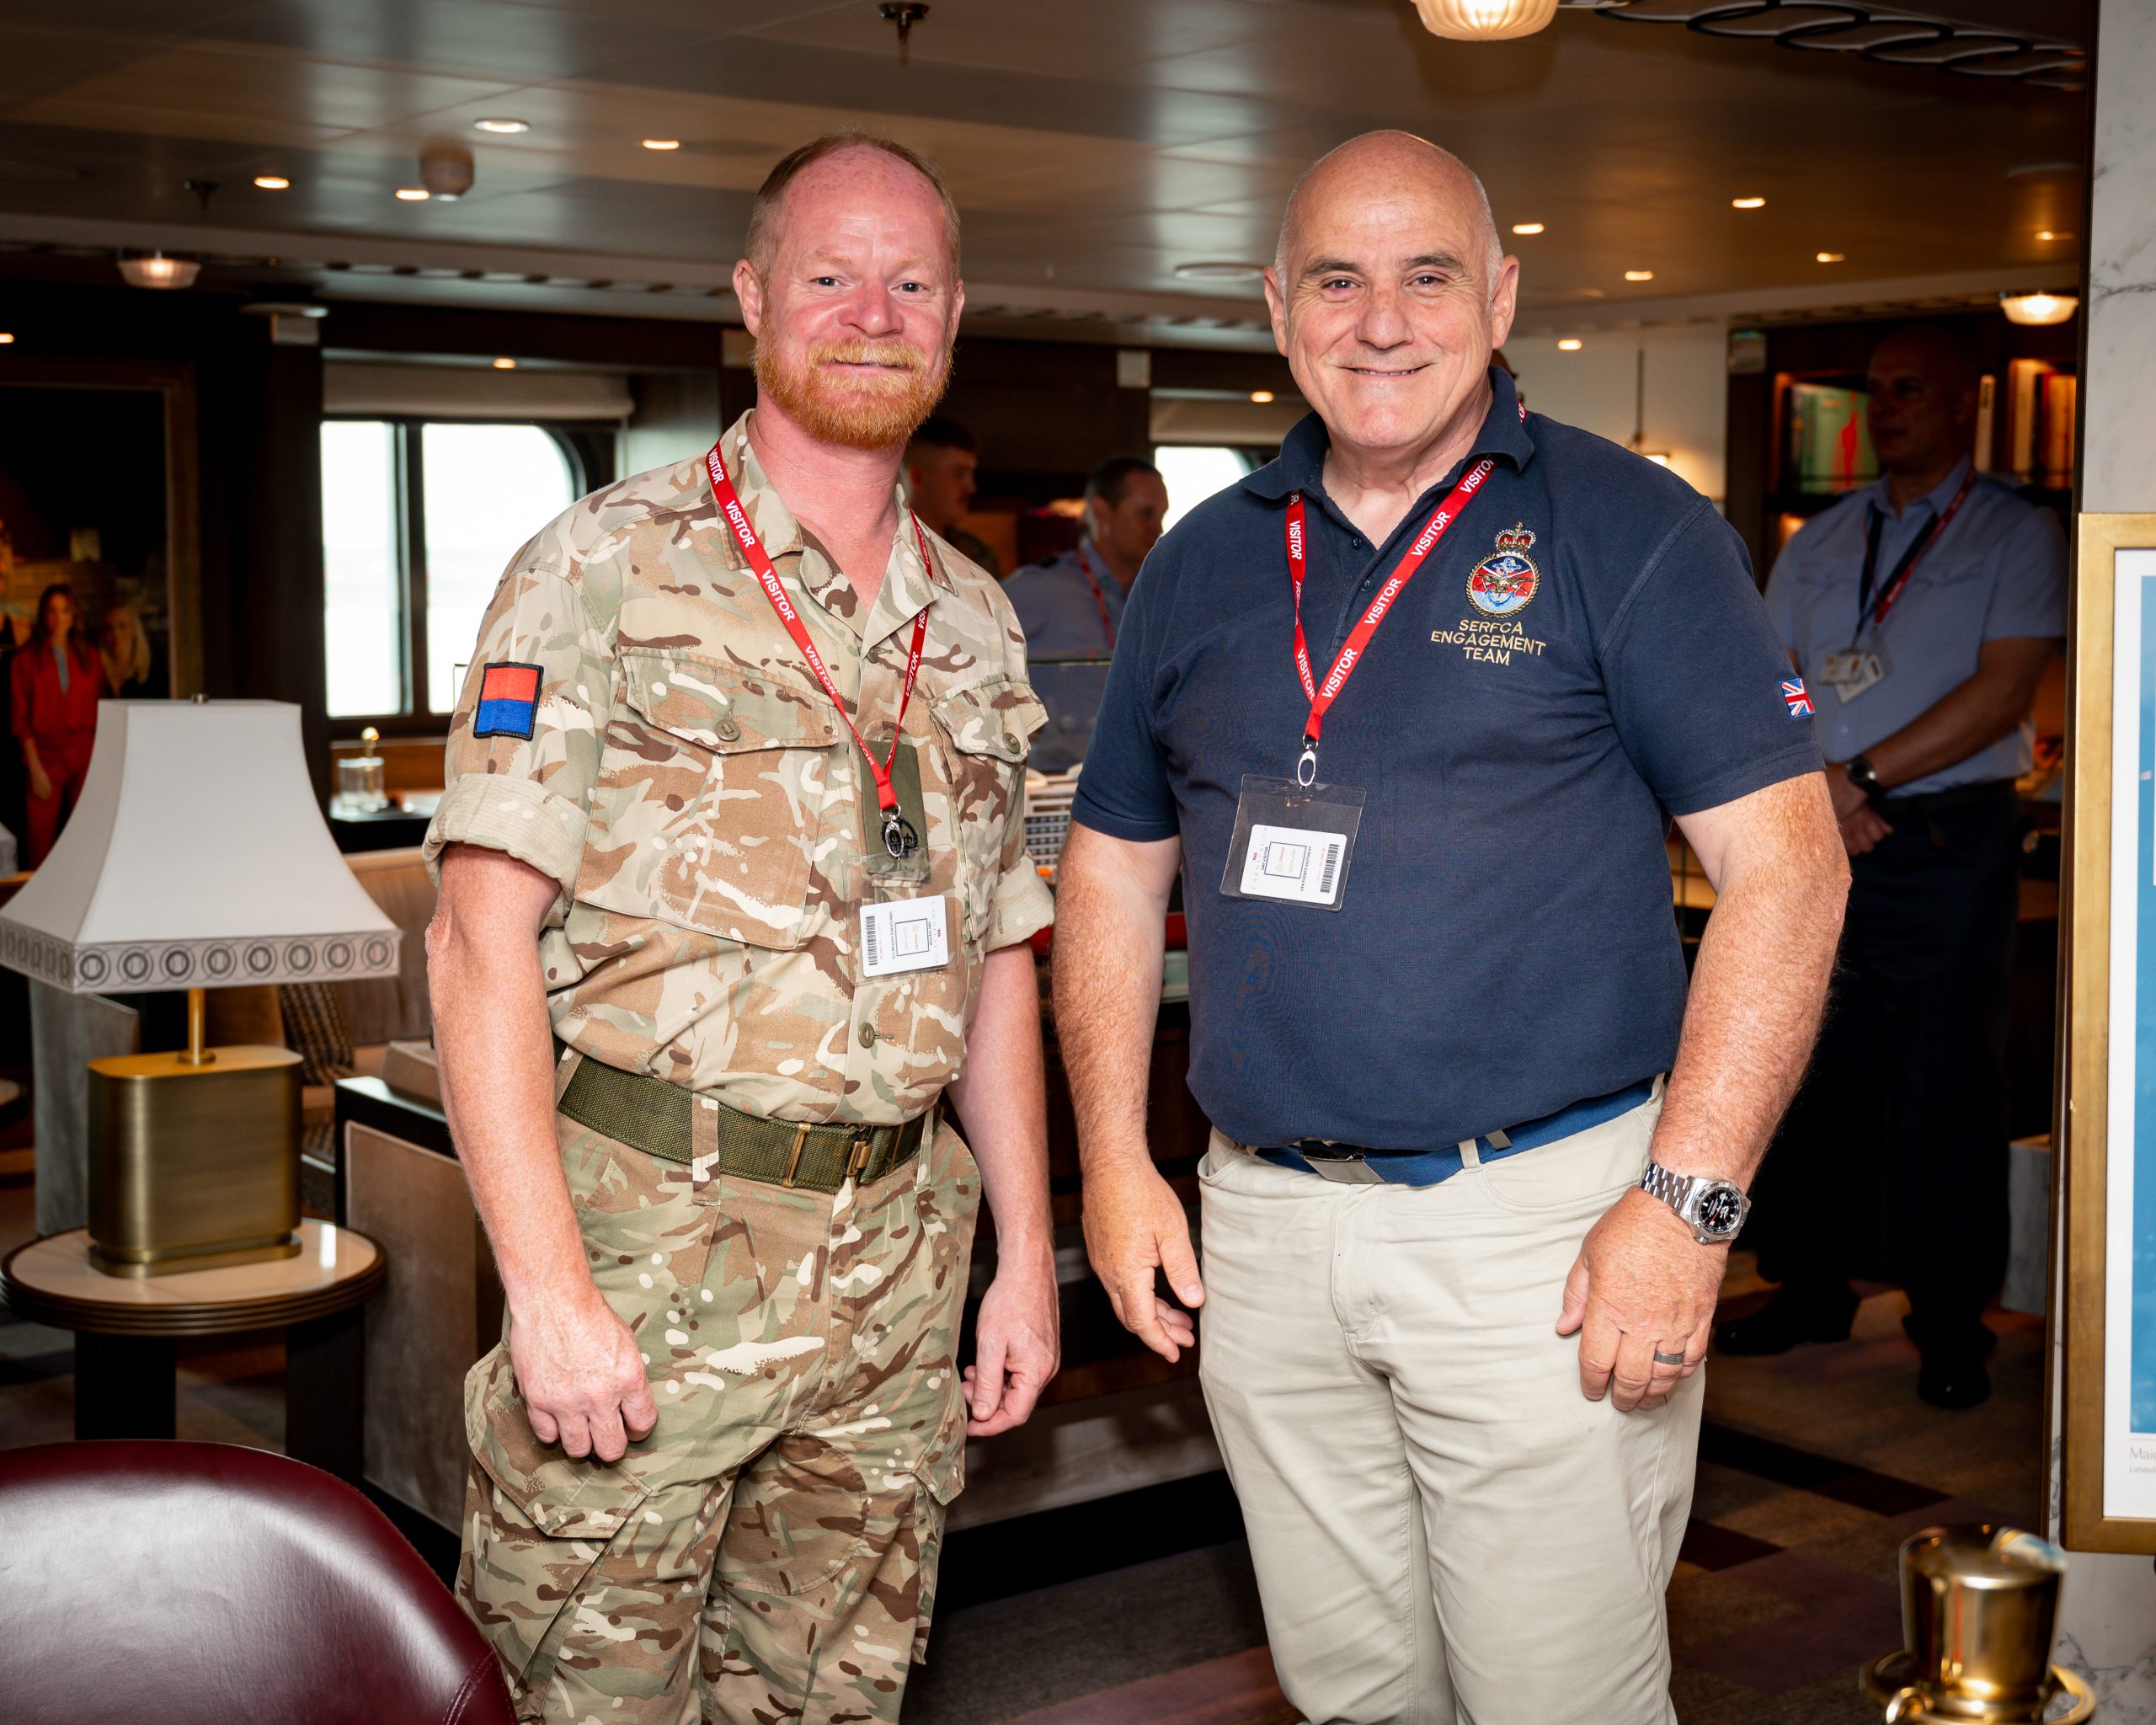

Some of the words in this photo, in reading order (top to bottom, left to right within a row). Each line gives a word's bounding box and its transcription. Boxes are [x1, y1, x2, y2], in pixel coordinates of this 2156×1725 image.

[708, 448, 724, 484] VISITOR
[725, 500, 755, 548] VISITOR
[1289, 521, 1302, 560] VISITOR
[1411, 511, 1451, 558] VISITOR
[761, 569, 795, 622] VISITOR
[1364, 578, 1402, 626] VISITOR
[1430, 630, 1547, 656] ENGAGEMENT
[1459, 619, 1523, 635] SERFCA
[805, 645, 836, 695] VISITOR
[905, 651, 919, 697] VISITOR
[1297, 648, 1315, 701] VISITOR
[1321, 648, 1358, 699] VISITOR
[1462, 646, 1510, 666] TEAM
